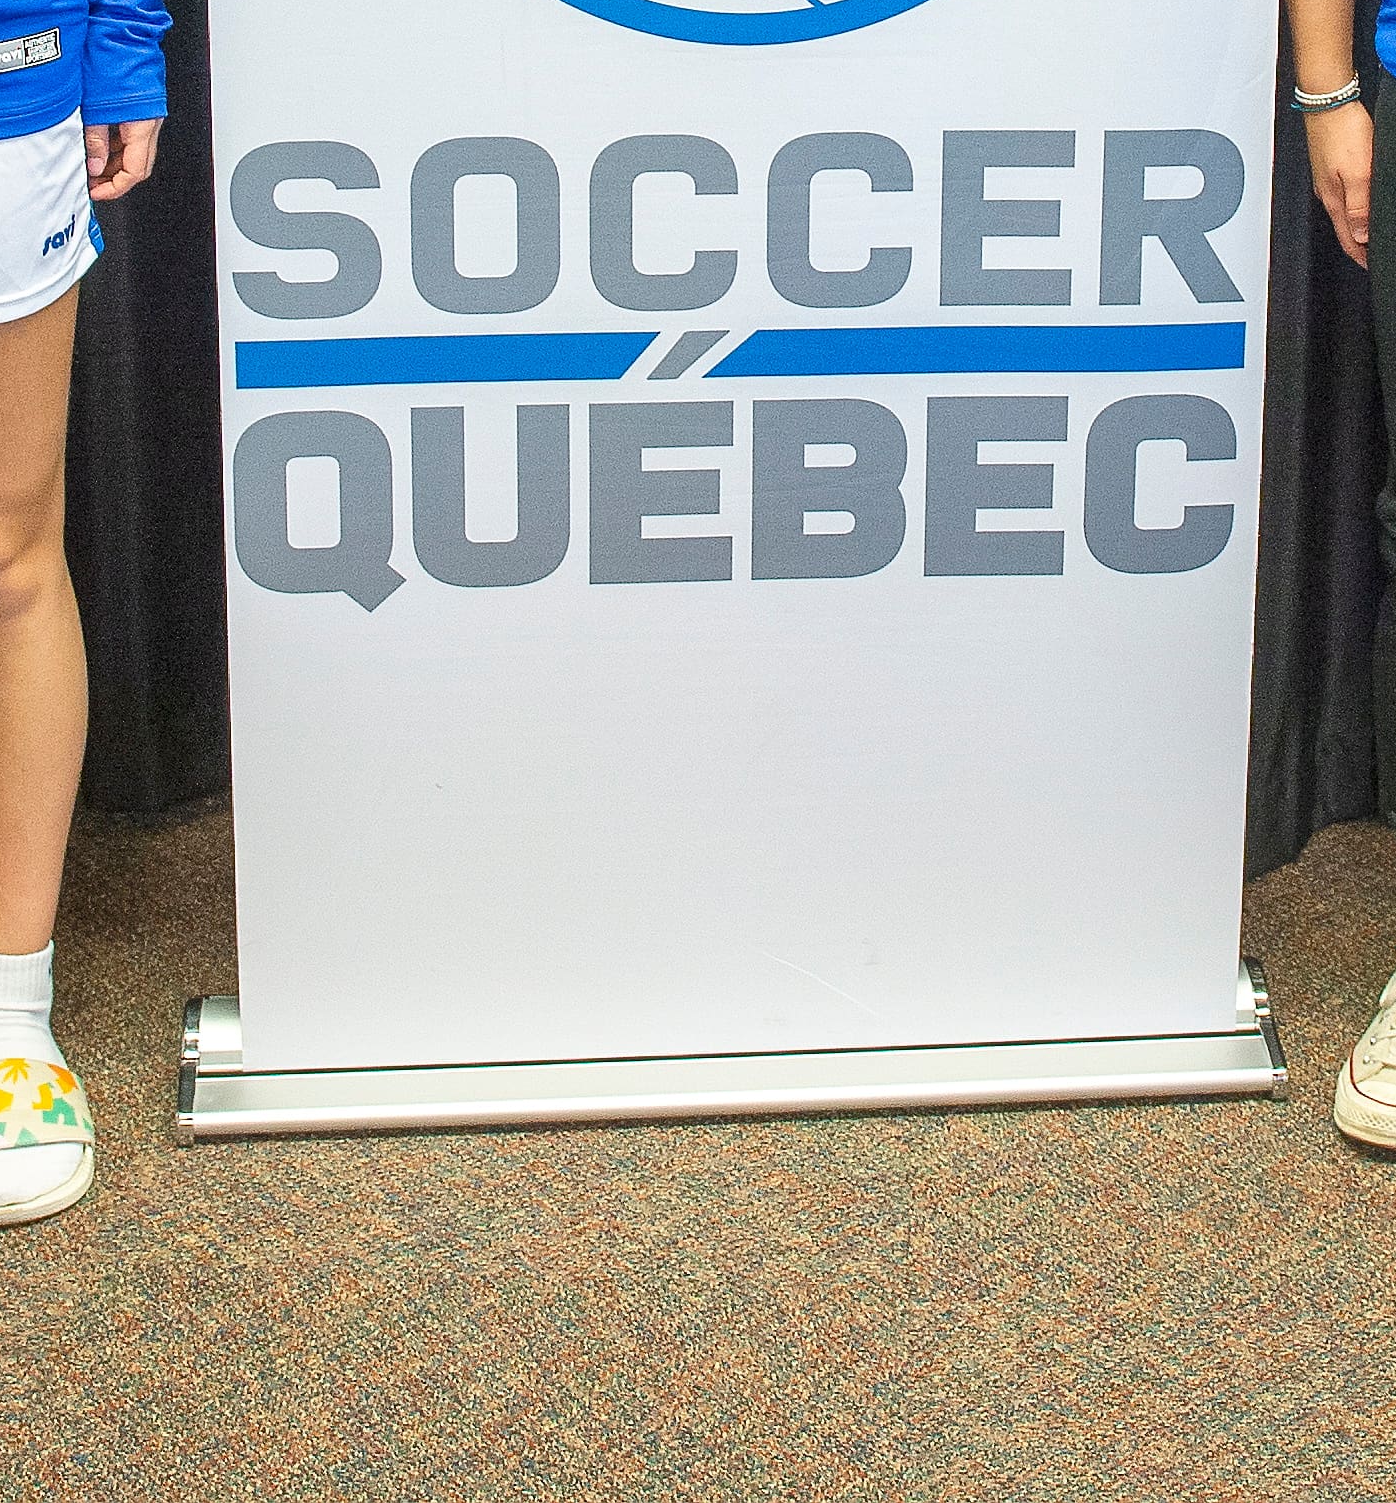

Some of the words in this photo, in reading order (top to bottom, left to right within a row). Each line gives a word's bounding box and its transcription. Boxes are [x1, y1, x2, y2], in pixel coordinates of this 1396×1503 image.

[43, 214, 75, 256] savi
[230, 129, 1245, 319] SOCCER
[233, 330, 1238, 612] QUÉBEC
